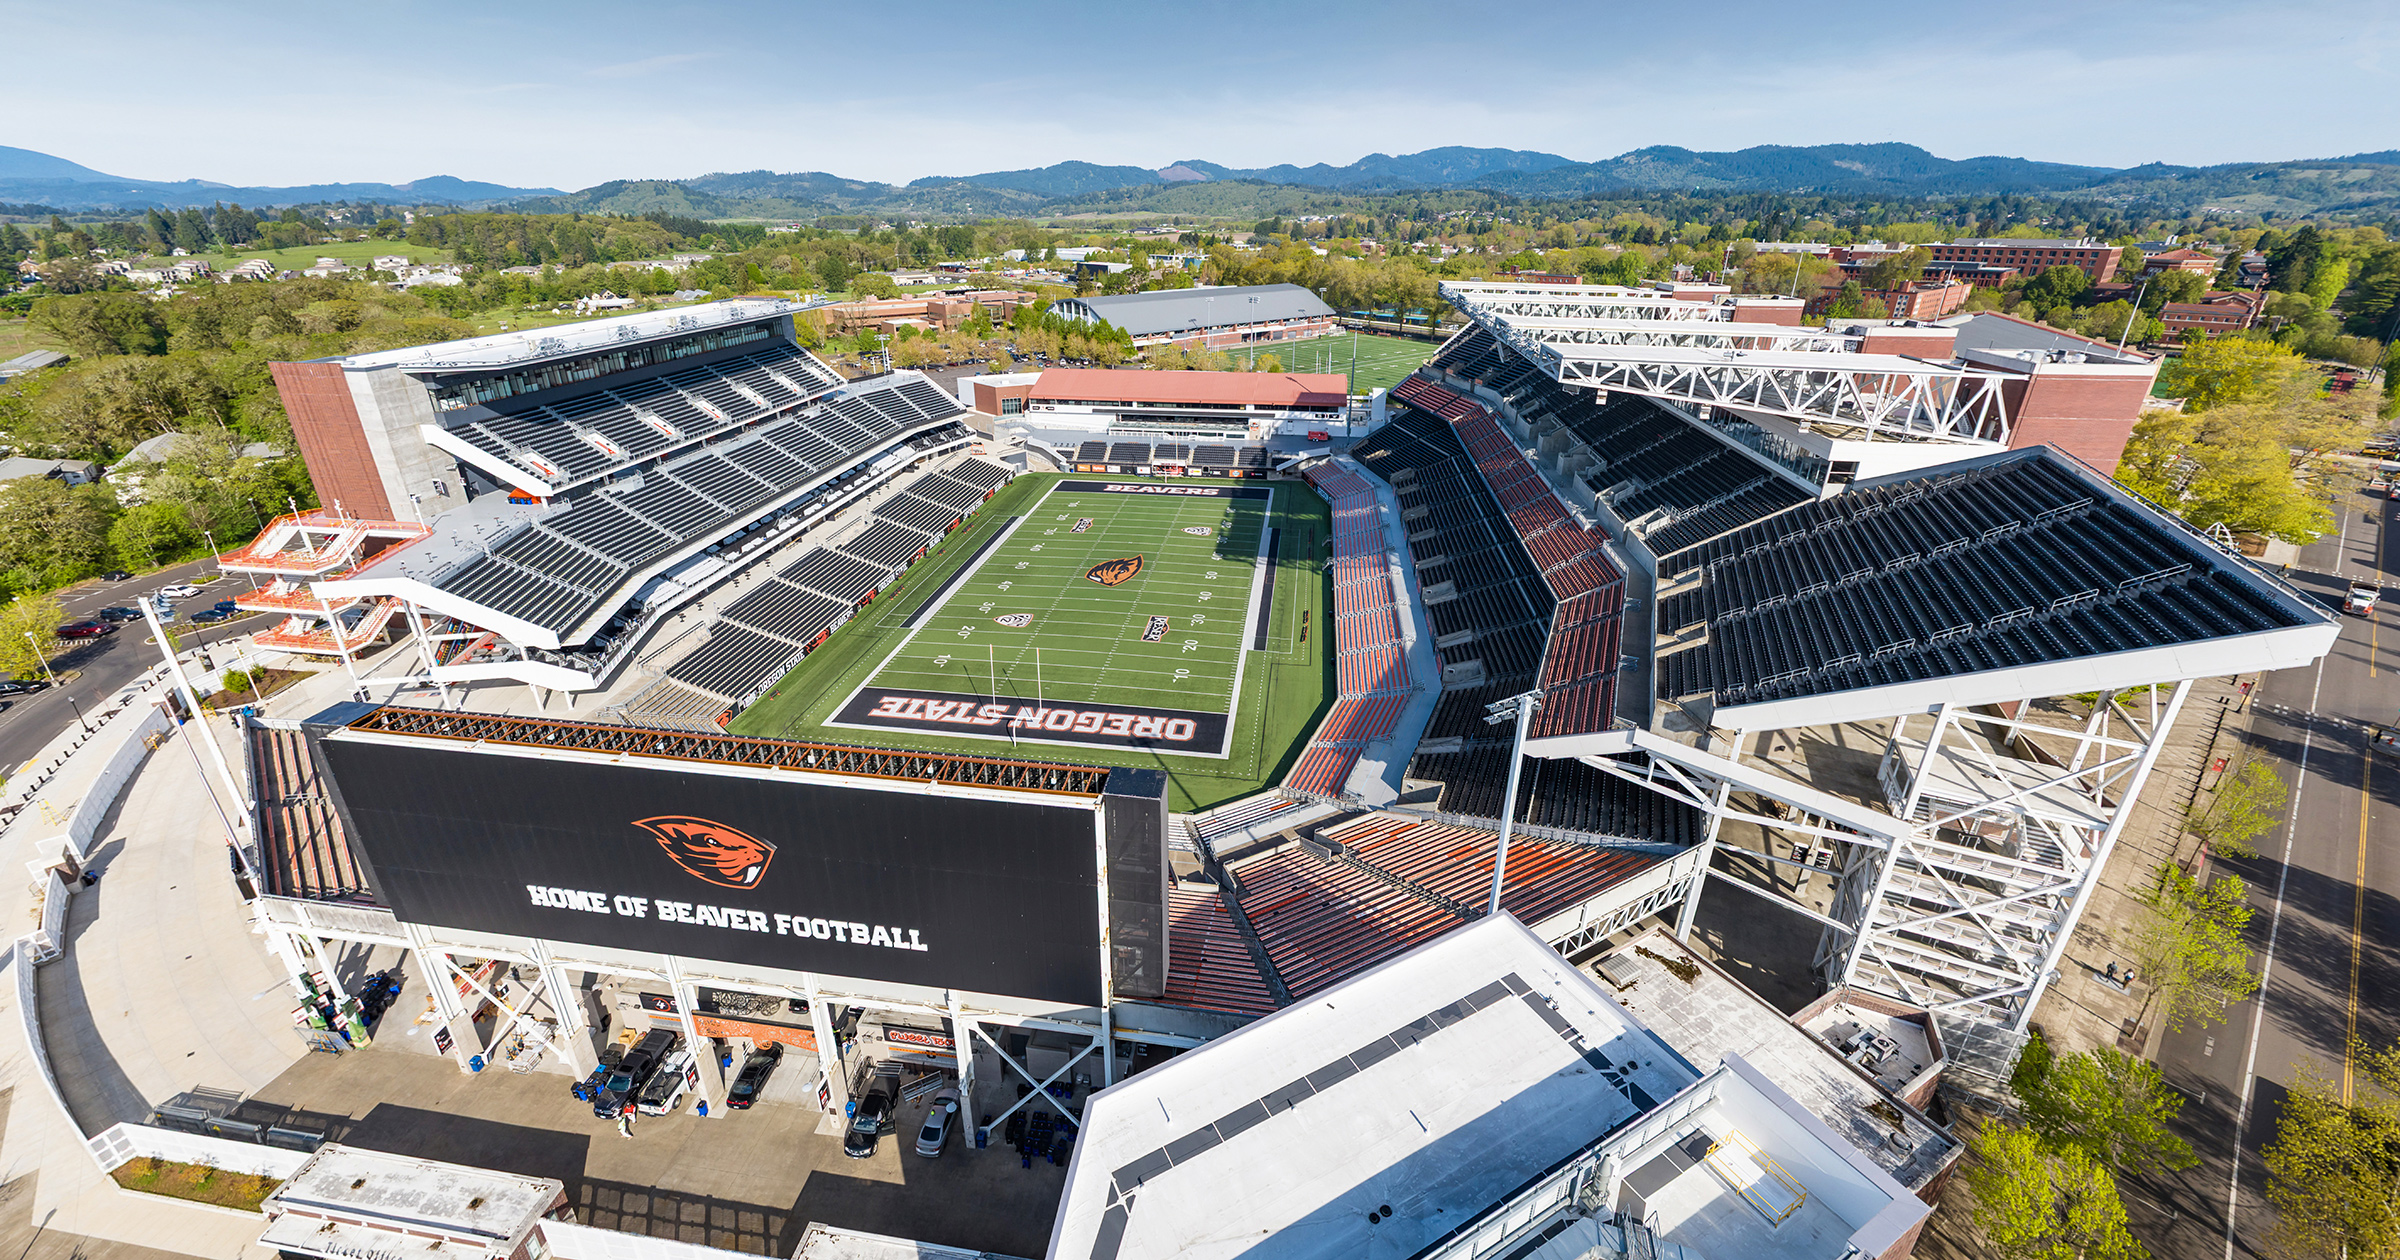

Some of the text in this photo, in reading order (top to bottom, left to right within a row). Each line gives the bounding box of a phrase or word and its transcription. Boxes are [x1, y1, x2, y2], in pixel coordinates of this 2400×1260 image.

[1104, 484, 1219, 496] BEAVERS
[1014, 561, 1030, 569] 50
[1205, 571, 1218, 580] 50
[997, 580, 1013, 590] 40
[1199, 590, 1212, 601] 40
[978, 601, 996, 612] 30
[1192, 613, 1206, 625] 30
[957, 625, 976, 637] 20
[1146, 617, 1167, 641] RESER
[1184, 639, 1199, 651] 20
[933, 654, 951, 664] 10
[757, 649, 806, 694] OREGON STATE
[1174, 668, 1190, 679] 10
[868, 696, 1197, 741] OREGON STATE
[526, 884, 929, 952] HOME OF BEAVER FOOTBALL
